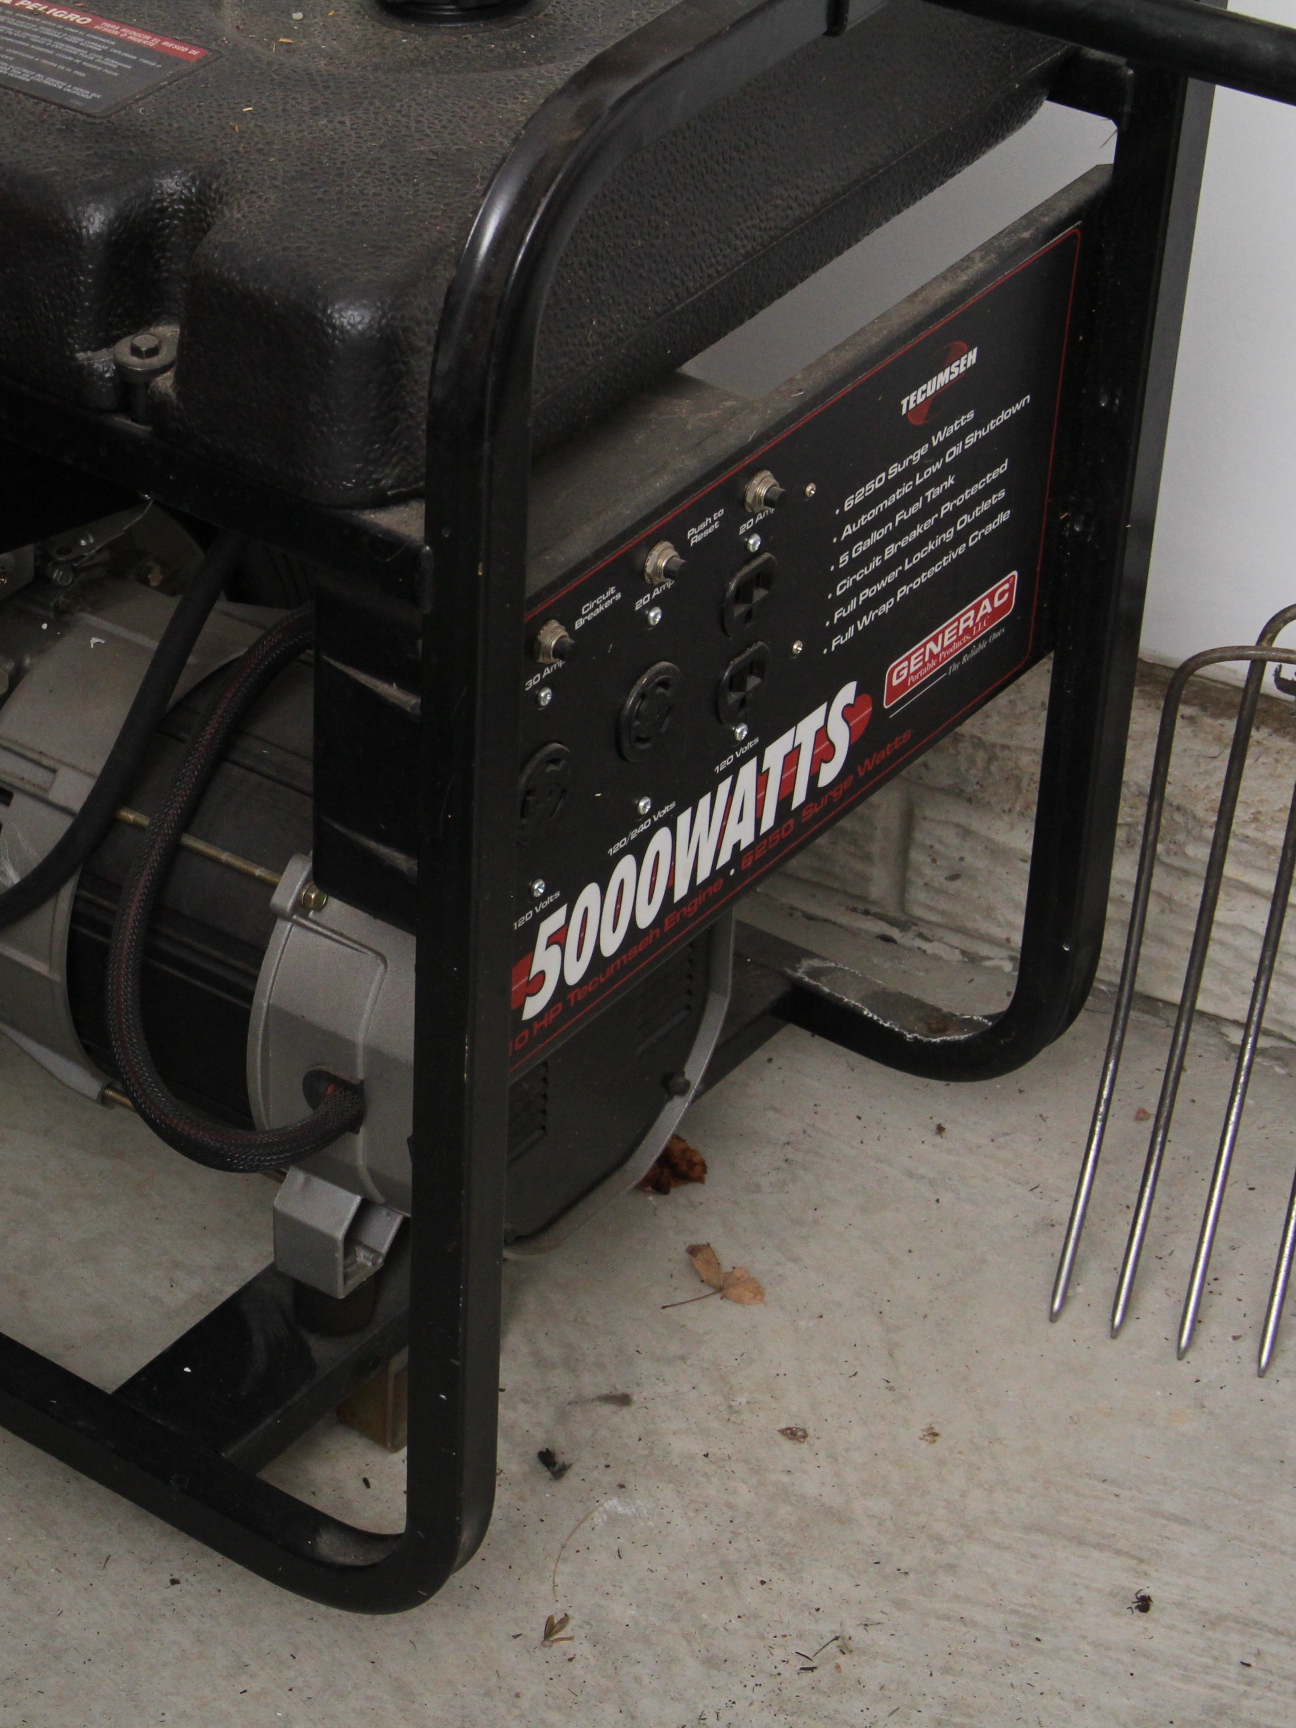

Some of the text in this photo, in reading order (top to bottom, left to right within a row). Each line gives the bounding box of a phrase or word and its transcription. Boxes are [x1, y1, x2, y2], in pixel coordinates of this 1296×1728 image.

[15, 0, 92, 25] PELIGRO
[901, 347, 978, 415] TECUMSEH
[841, 394, 1031, 541] Automatic Low Oil Shutdown
[844, 409, 975, 512] 6250 Surge Watts
[687, 508, 724, 540] Push to
[690, 521, 720, 547] Reset
[739, 518, 754, 535] 20
[836, 458, 1008, 596] Circuit Breaker Protected
[838, 474, 956, 569] 5 Gallon Fuel Tank
[831, 509, 1011, 652] Full Wrap Protective Cradle
[833, 488, 1006, 624] Full Power Locking Outlets
[575, 591, 622, 630] Breakers
[581, 585, 617, 615] Circuit
[635, 594, 651, 611] 20
[892, 582, 1010, 686] GENERAC
[907, 616, 990, 686] Portable Products, LLC
[948, 660, 961, 676] The
[961, 640, 988, 665] Reliable
[525, 673, 541, 691] 30
[714, 737, 759, 774] 120 Volts
[522, 681, 857, 1021] 5000WATTS
[608, 800, 677, 856] 120/240 Volts
[513, 890, 561, 930] 120 Volts
[533, 1002, 562, 1036] HP
[567, 928, 660, 1006] Tecumseh
[663, 877, 724, 933] Engine
[741, 817, 795, 870] 6250
[801, 775, 854, 822] Surge
[857, 729, 912, 777] Watts
